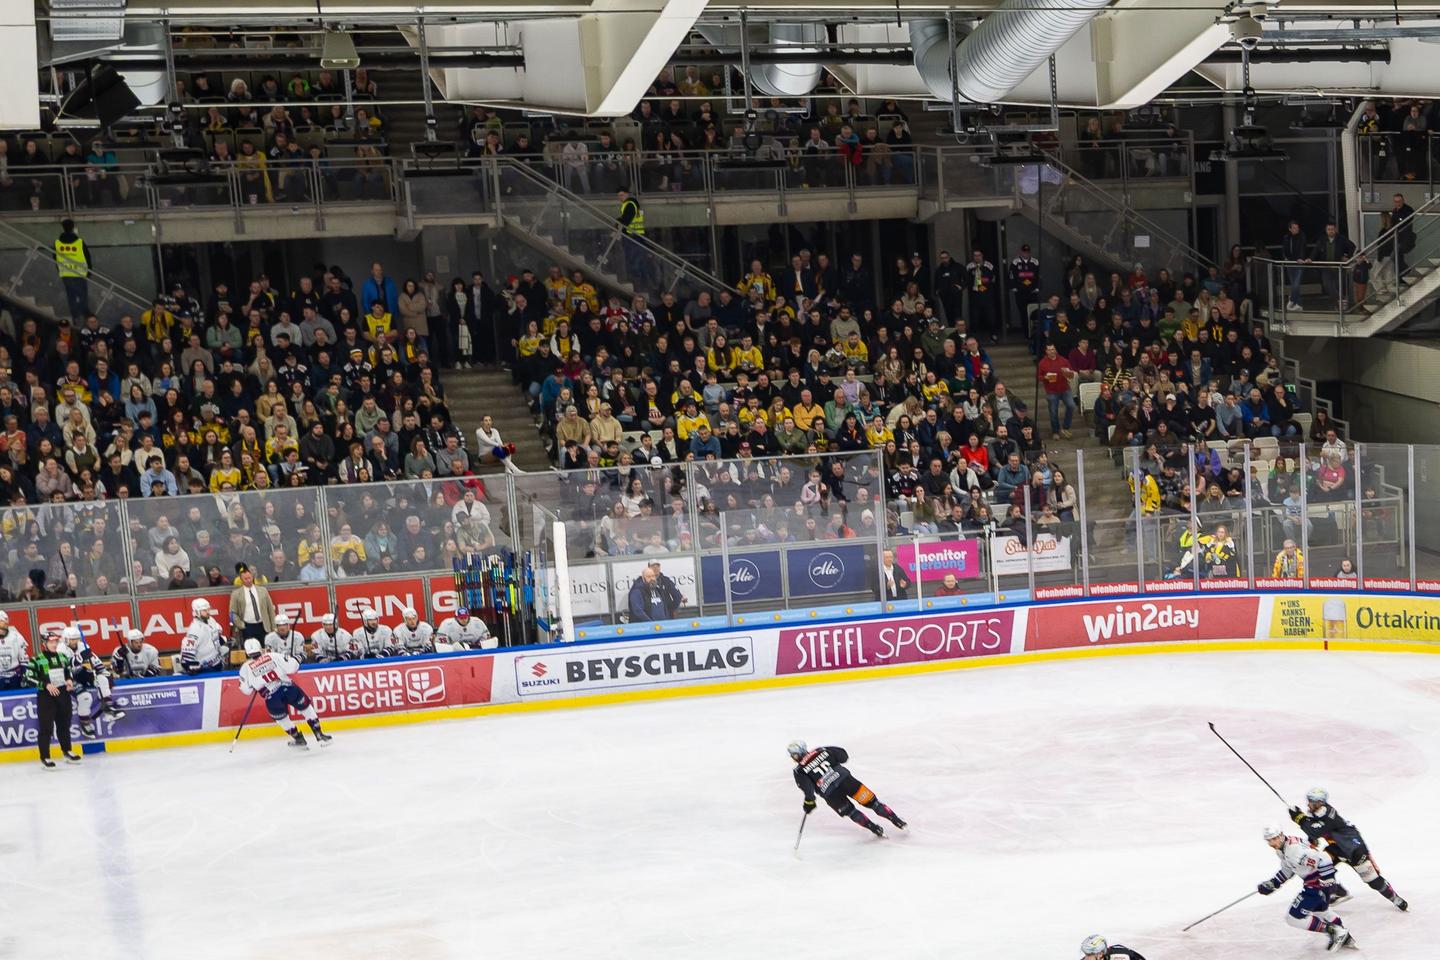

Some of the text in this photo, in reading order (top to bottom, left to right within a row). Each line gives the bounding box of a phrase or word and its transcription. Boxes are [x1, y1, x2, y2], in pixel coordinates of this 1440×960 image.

[1083, 603, 1199, 642] win2day
[795, 618, 1001, 670] STEFFL SPORTS
[566, 646, 749, 683] BEYSCHLAG
[131, 691, 177, 701] BESTATTUNG
[314, 670, 402, 693] WIENER
[521, 678, 560, 688] SUZUKI
